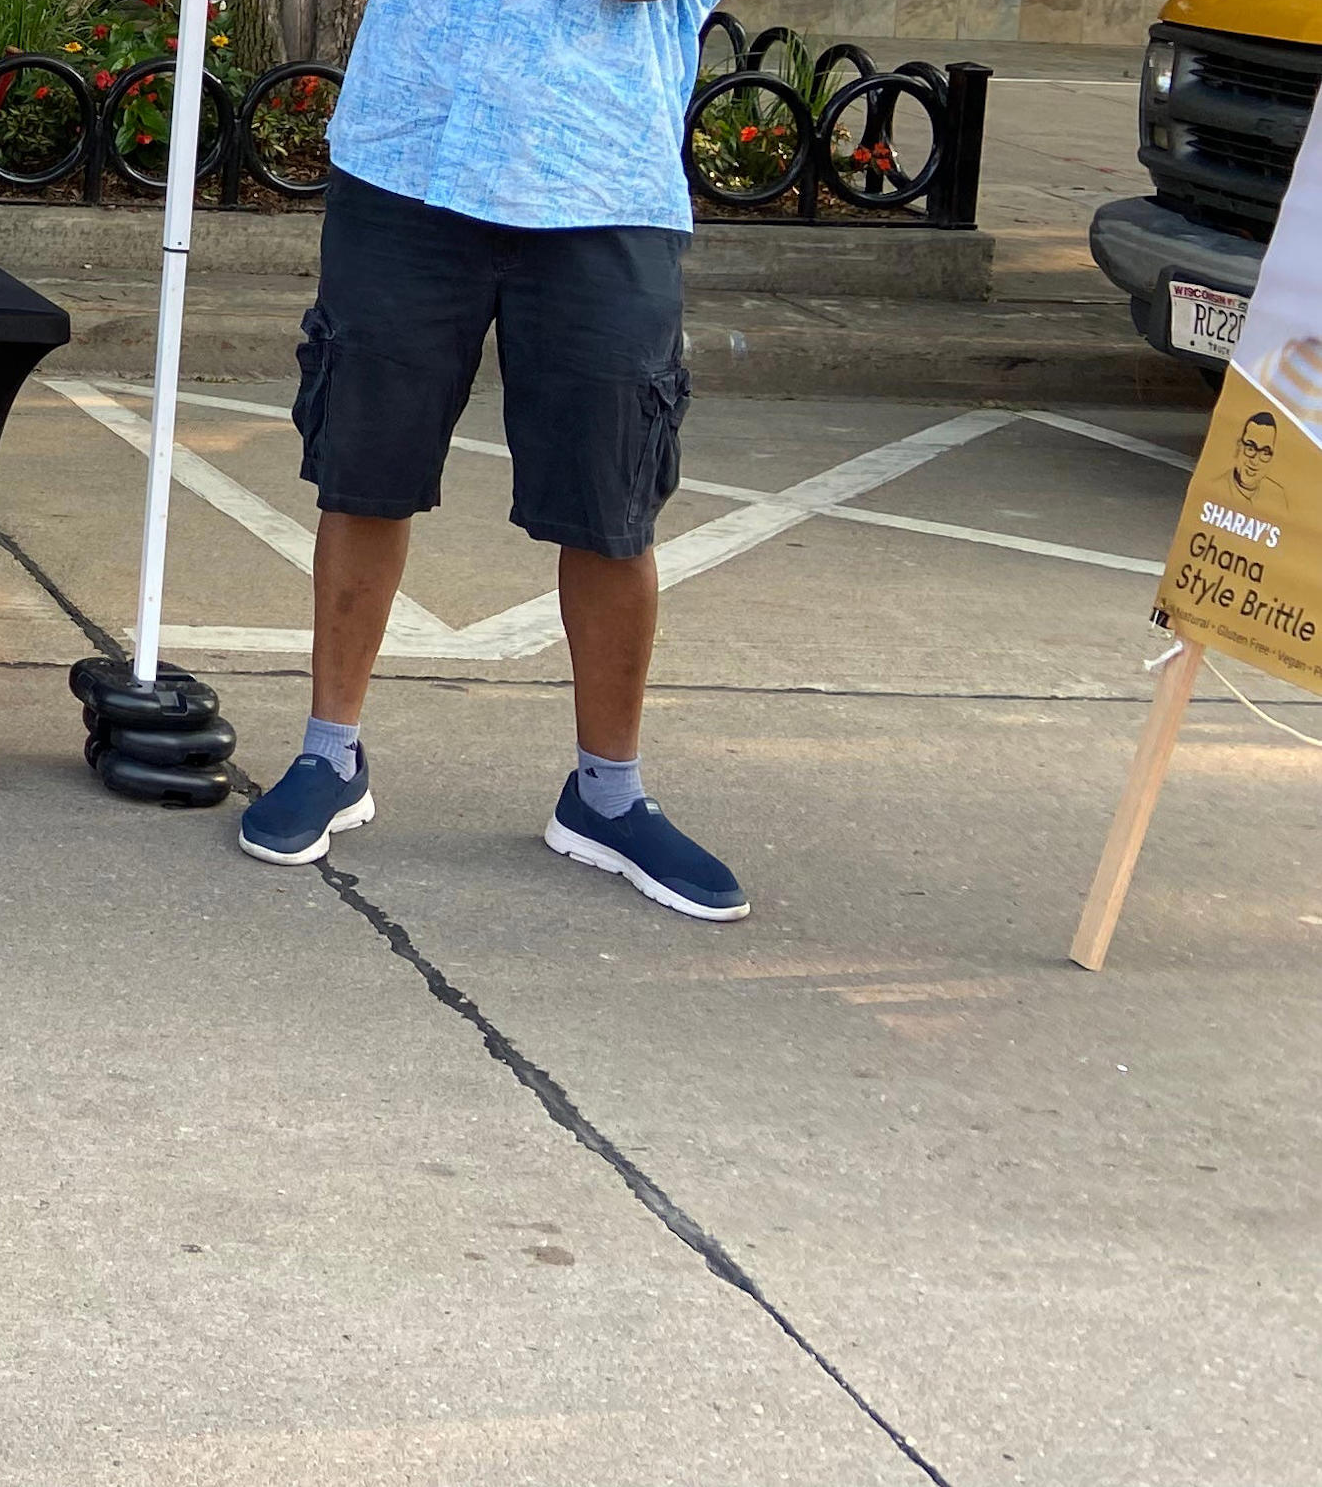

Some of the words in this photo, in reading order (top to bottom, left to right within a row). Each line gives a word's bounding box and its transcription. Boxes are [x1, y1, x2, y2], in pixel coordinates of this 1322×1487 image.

[1200, 501, 1281, 548] SHARAY'S
[1190, 532, 1264, 583] Ghana
[1175, 564, 1235, 606] Style
[1240, 589, 1316, 642] Brittle
[1217, 624, 1248, 645] Gluten
[1277, 650, 1307, 671] Vegan
